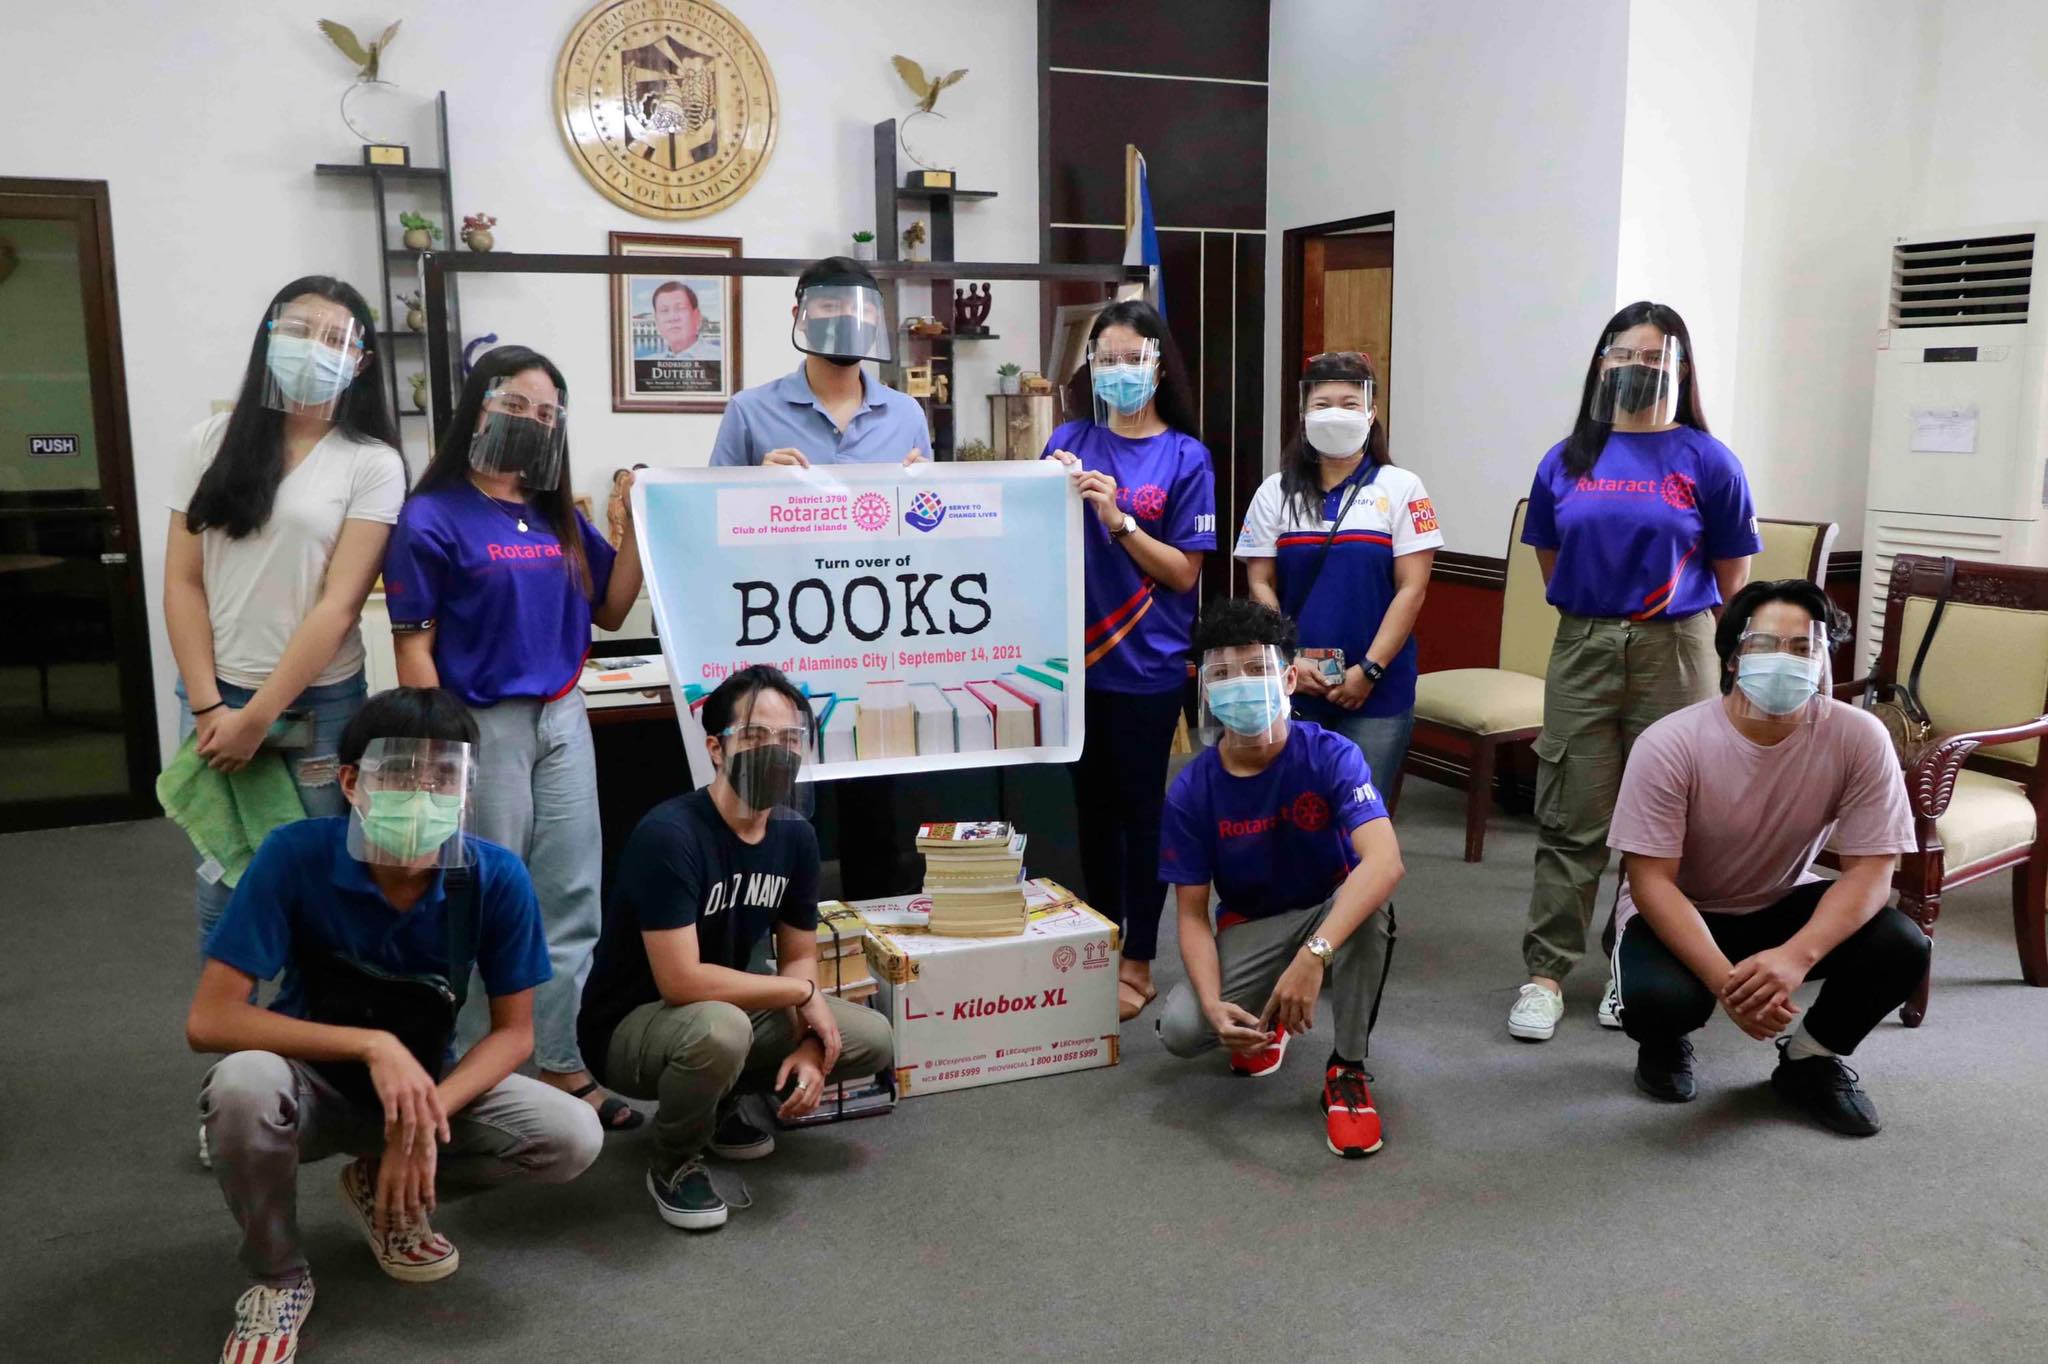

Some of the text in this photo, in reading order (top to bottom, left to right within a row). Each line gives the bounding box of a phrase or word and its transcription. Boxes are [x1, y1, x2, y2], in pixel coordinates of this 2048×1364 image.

[595, 154, 748, 204] CITY OF ALAMINOS
[32, 439, 73, 452] PUSH
[788, 495, 847, 504] District 3790
[770, 504, 848, 522] Rotaract
[732, 526, 755, 534] Club
[771, 524, 811, 533] Hundred
[815, 523, 847, 531] Islands
[815, 554, 911, 569] Turn over of
[733, 572, 992, 647] BOOKS
[702, 662, 728, 680] City
[782, 657, 794, 673] of
[799, 654, 858, 671] Alaminos
[862, 652, 887, 671] City
[899, 650, 966, 668] September
[971, 648, 988, 663] 14,
[993, 645, 1022, 660] 2021
[704, 873, 790, 916] OLD NAVY
[952, 988, 1068, 1020] Kilobox XL
[1006, 1046, 1042, 1056] LBCexpress
[1060, 1038, 1095, 1048] LBCexpress
[1037, 1055, 1051, 1065] 800
[1053, 1054, 1062, 1062] 10
[1063, 1051, 1078, 1061] 858
[1079, 1048, 1098, 1059] 5999
[961, 1066, 981, 1077] 5999
